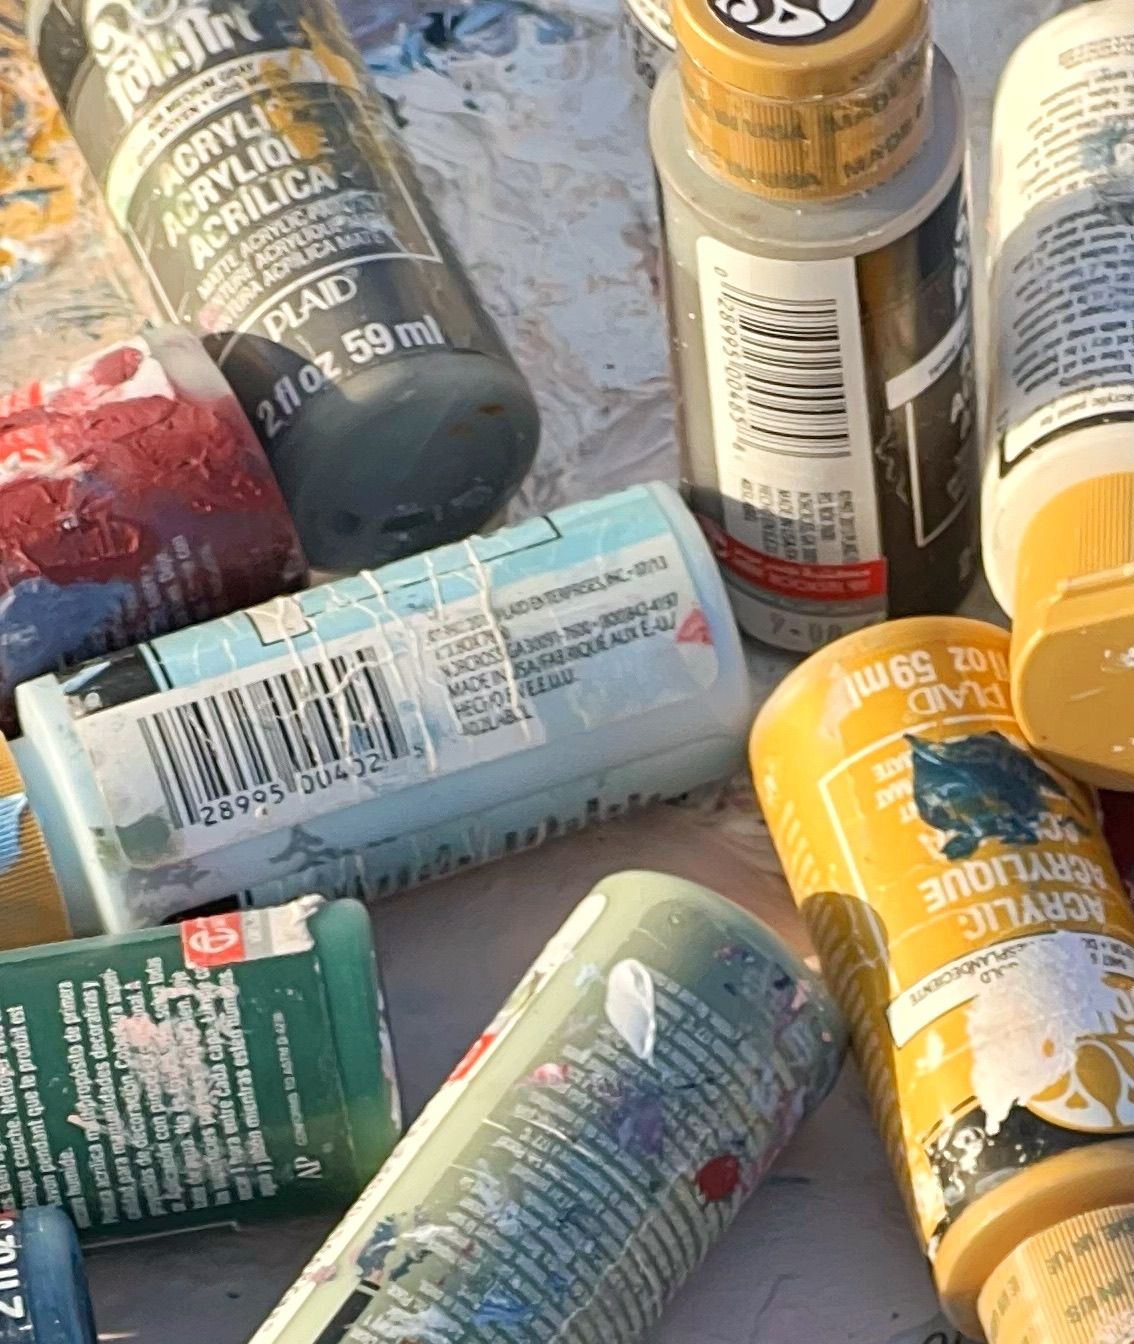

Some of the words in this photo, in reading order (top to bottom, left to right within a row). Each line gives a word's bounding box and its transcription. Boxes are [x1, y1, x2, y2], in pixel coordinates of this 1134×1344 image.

[261, 270, 358, 343] PLAID
[252, 396, 290, 439] 2
[296, 347, 342, 396] oz
[339, 317, 399, 365] 59
[392, 311, 447, 351] ml
[886, 647, 938, 690] 59
[946, 646, 987, 672] oz
[842, 660, 890, 709] ml
[908, 678, 1008, 717] PLAID
[201, 783, 285, 826] 28995
[916, 852, 1108, 914] ACRYLIQUE
[956, 889, 1107, 940] ACRYLIC
[6, 1006, 25, 1023] est
[58, 980, 81, 1023] primera
[10, 1027, 37, 1071] produit
[65, 1026, 82, 1041] de
[19, 1075, 35, 1088] le
[236, 1069, 261, 1127] mientras
[25, 1092, 45, 1116] que
[220, 1101, 238, 1134] entre
[5, 1116, 29, 1167] couche.
[27, 1119, 56, 1171] pendant
[154, 1116, 169, 1139] con
